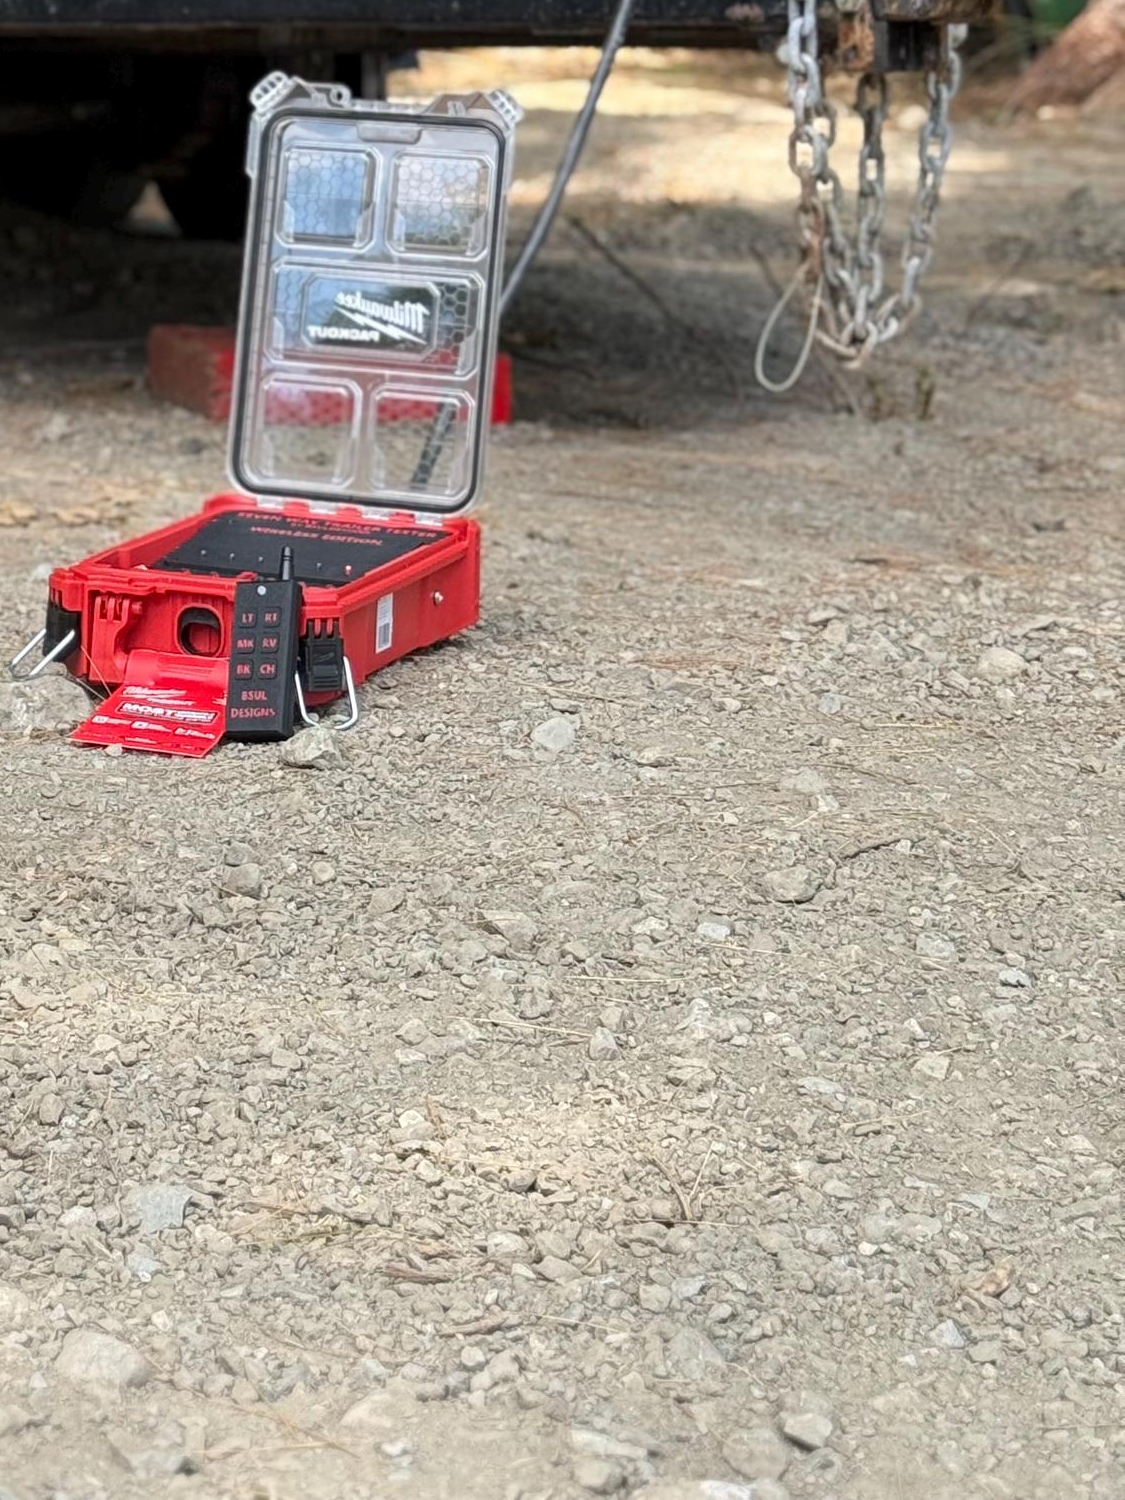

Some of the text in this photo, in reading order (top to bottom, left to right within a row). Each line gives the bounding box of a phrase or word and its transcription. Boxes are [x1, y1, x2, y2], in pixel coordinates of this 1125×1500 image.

[237, 511, 283, 522] SEVEN
[386, 527, 438, 539] TESTER
[250, 526, 320, 538] WIRELESS
[321, 533, 384, 546] EDITION
[241, 612, 255, 624] LT
[261, 637, 278, 649] RV
[236, 662, 276, 675] BK CH
[240, 690, 268, 701] BSUL
[230, 706, 276, 719] DESIGNS
